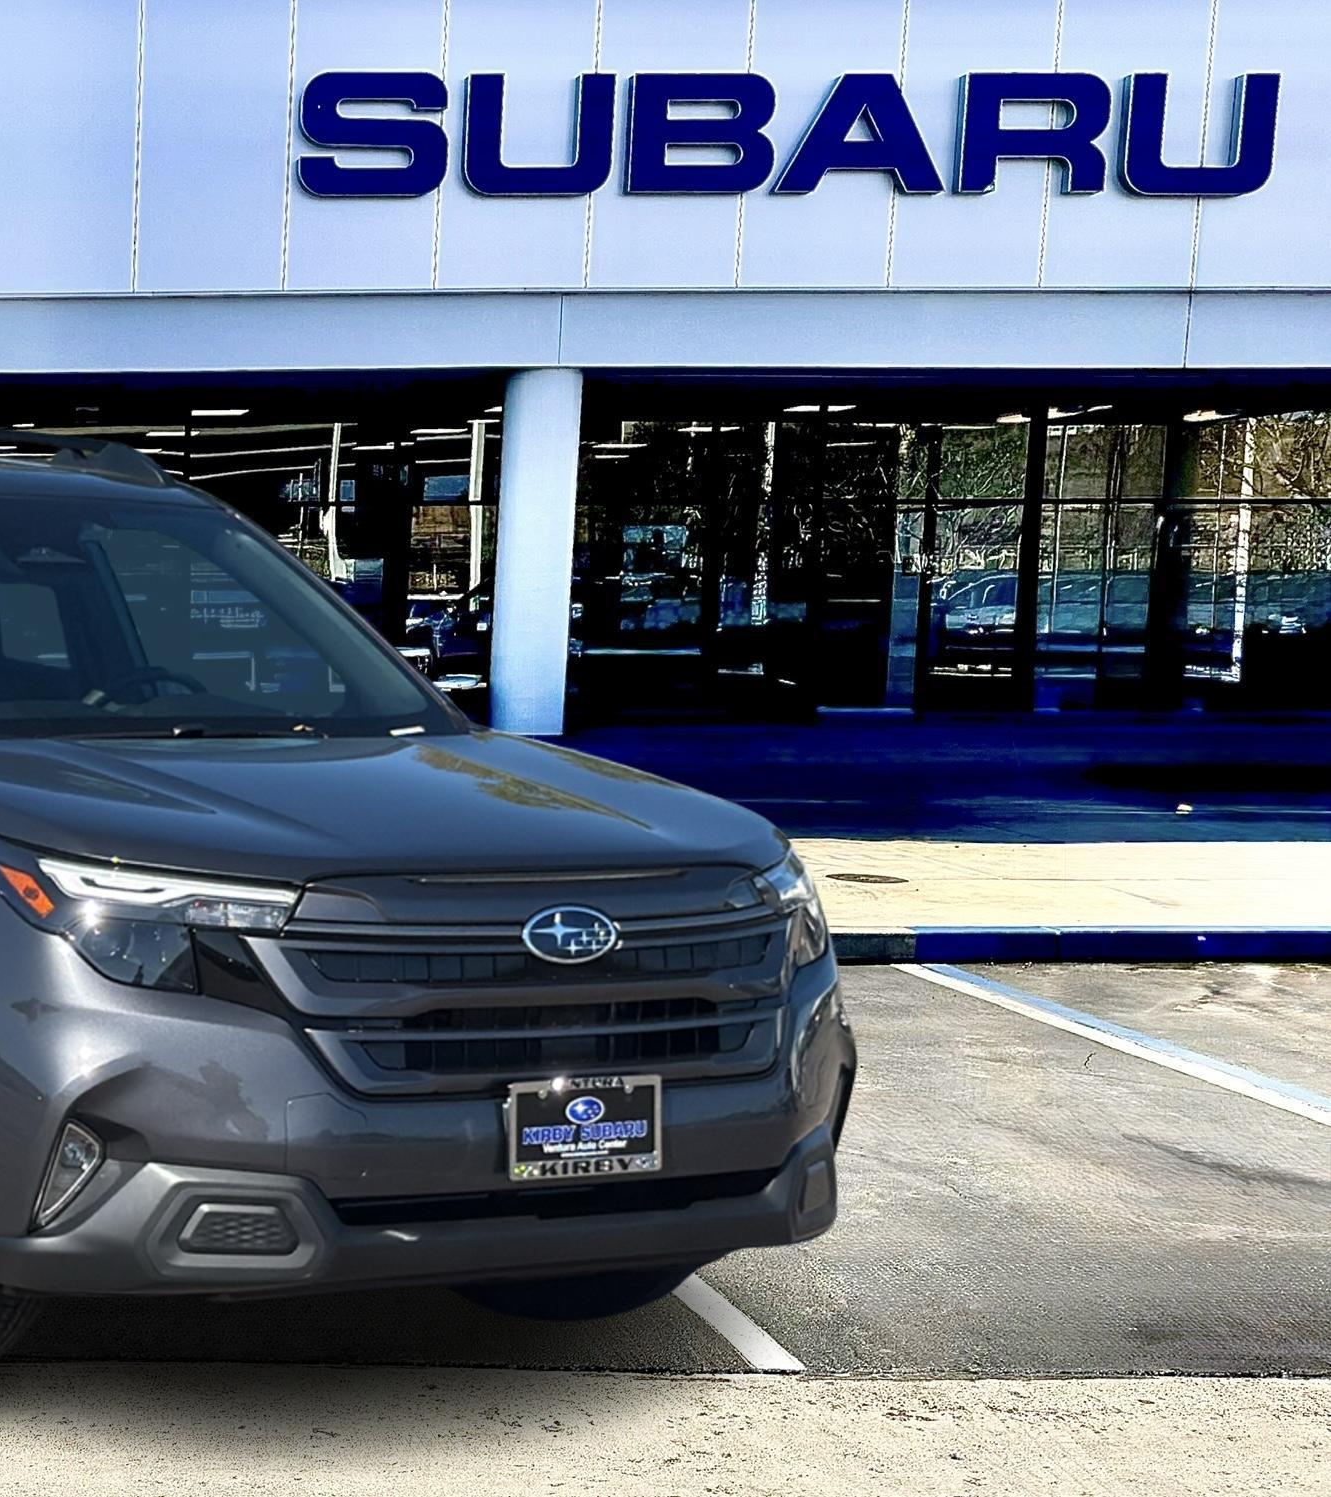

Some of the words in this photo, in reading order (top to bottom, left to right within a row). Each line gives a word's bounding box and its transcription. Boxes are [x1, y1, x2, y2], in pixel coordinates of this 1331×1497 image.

[297, 71, 1282, 197] SUBARU
[522, 1125, 576, 1145] KIRBY
[581, 1120, 647, 1140] SUBARU
[542, 1142, 576, 1153] Ventura
[577, 1141, 597, 1150] Auto
[598, 1140, 627, 1150] Center
[540, 1158, 633, 1176] KIRBY
